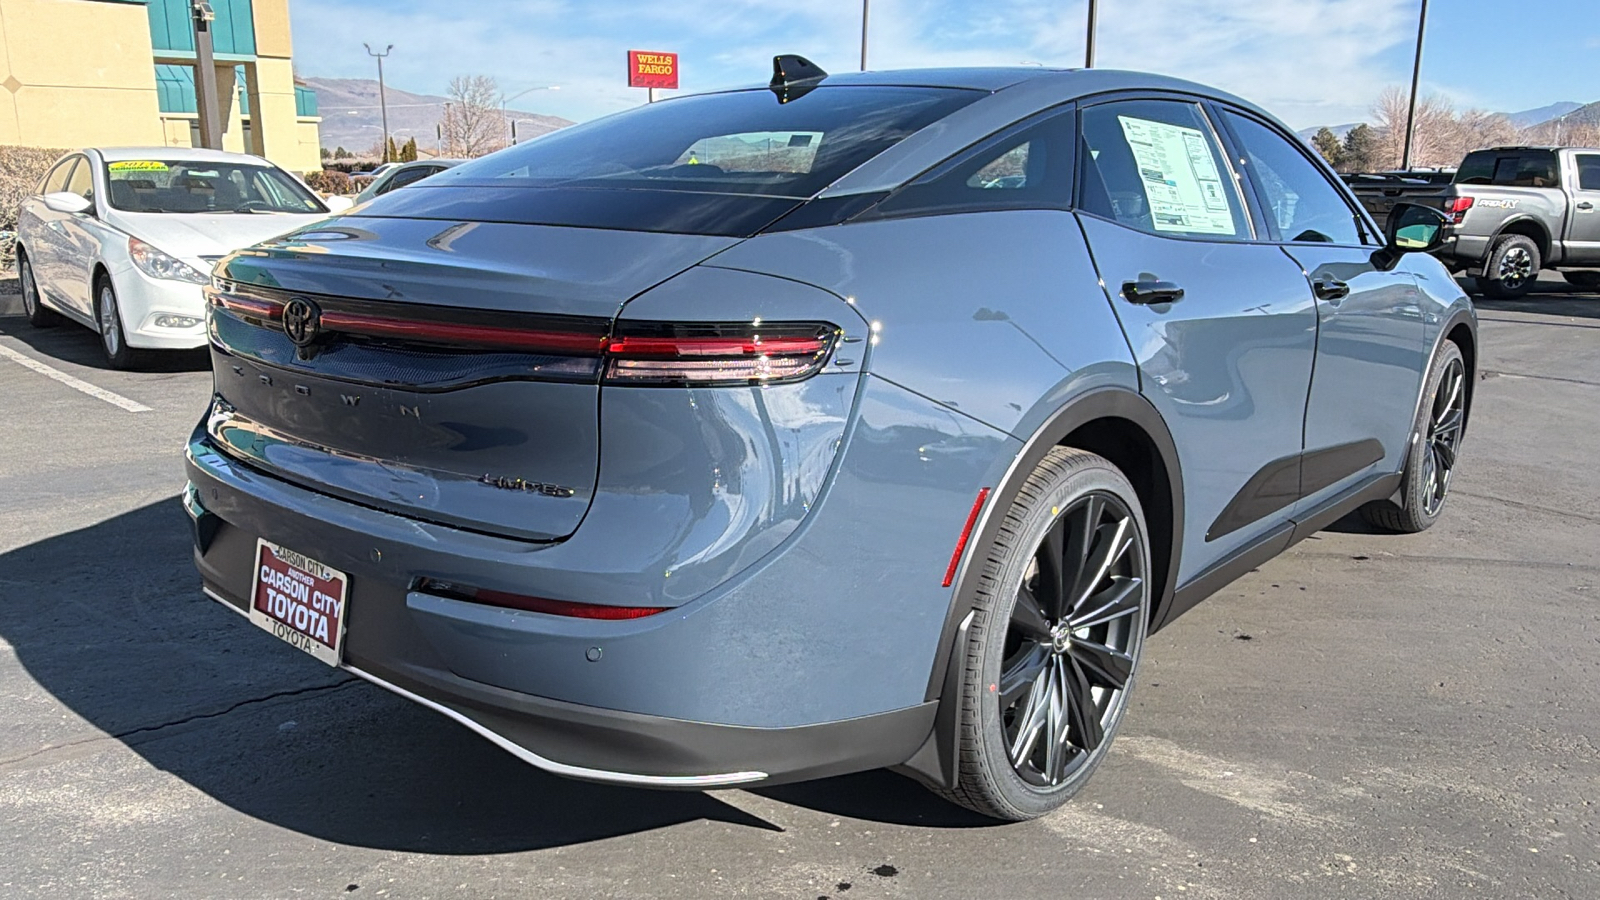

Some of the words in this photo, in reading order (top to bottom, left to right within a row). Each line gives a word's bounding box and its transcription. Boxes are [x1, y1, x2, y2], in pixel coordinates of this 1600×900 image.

[637, 54, 673, 66] WELLS
[638, 64, 673, 75] FARGO
[277, 546, 306, 570] CARSON
[307, 561, 326, 577] CITY
[287, 567, 315, 587] ANOTHER
[260, 565, 310, 604] CARSON
[312, 590, 341, 619] CITY
[266, 588, 329, 643] TOYOTA
[272, 620, 313, 653] TOYOTA
